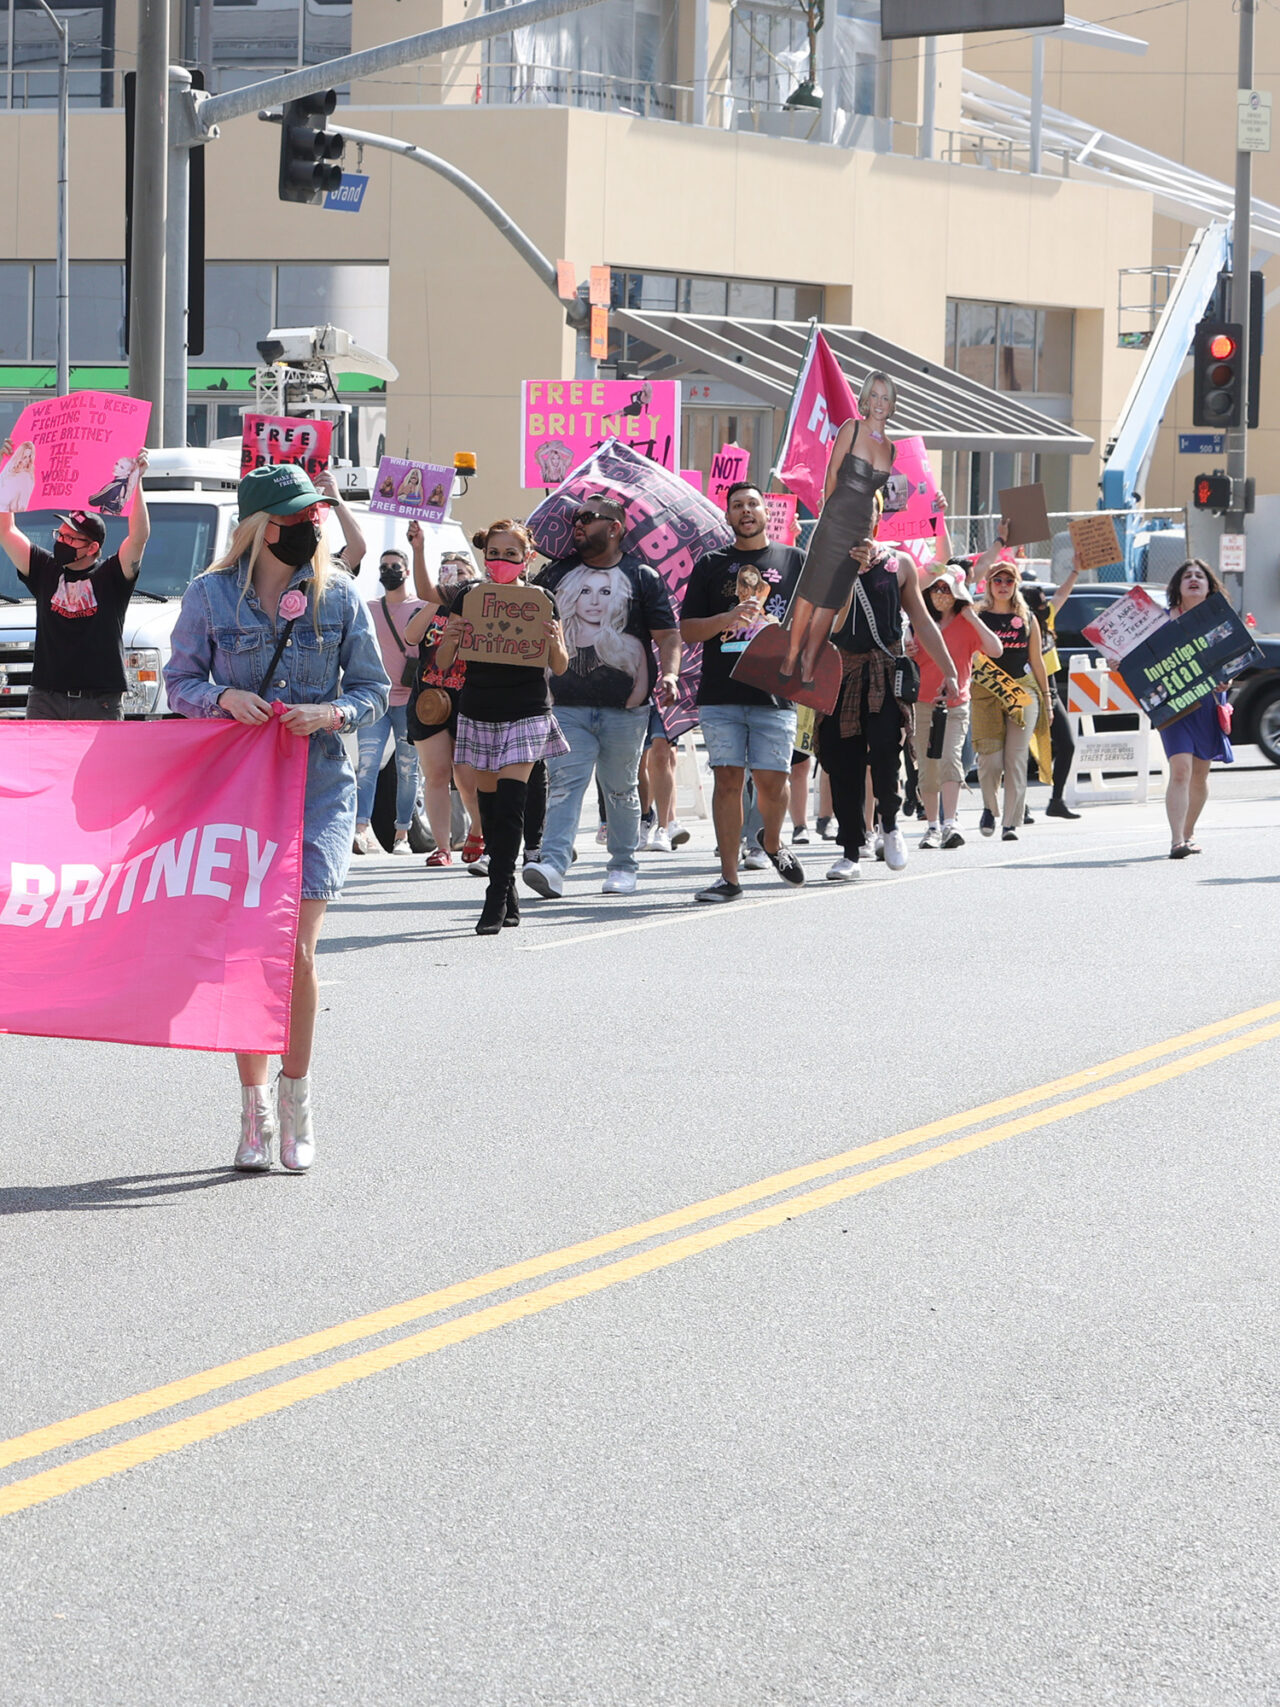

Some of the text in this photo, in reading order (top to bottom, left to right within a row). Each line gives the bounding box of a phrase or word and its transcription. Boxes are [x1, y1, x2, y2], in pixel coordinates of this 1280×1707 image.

[529, 383, 605, 405] FREE
[32, 397, 138, 417] WE WILL KEEP
[31, 411, 107, 431] FIGHTING TO
[529, 412, 661, 439] BRITNEY
[33, 426, 113, 445] FREE BRITNEY
[256, 422, 310, 446] FREE
[50, 442, 78, 456] TILL
[49, 456, 73, 470] THE
[241, 449, 329, 474] BRINEY
[390, 457, 410, 466] WHAT
[412, 461, 426, 470] SHE
[712, 456, 742, 480] NOT
[41, 470, 79, 483] WORLD
[346, 473, 358, 487] 12
[41, 483, 73, 496] ENDS
[371, 501, 443, 520] FREE BRITNEY
[482, 593, 539, 621] Free
[460, 623, 546, 659] Britney
[981, 661, 1026, 697] FREE
[1162, 660, 1203, 695] Edan
[972, 665, 1023, 712] RITNEY
